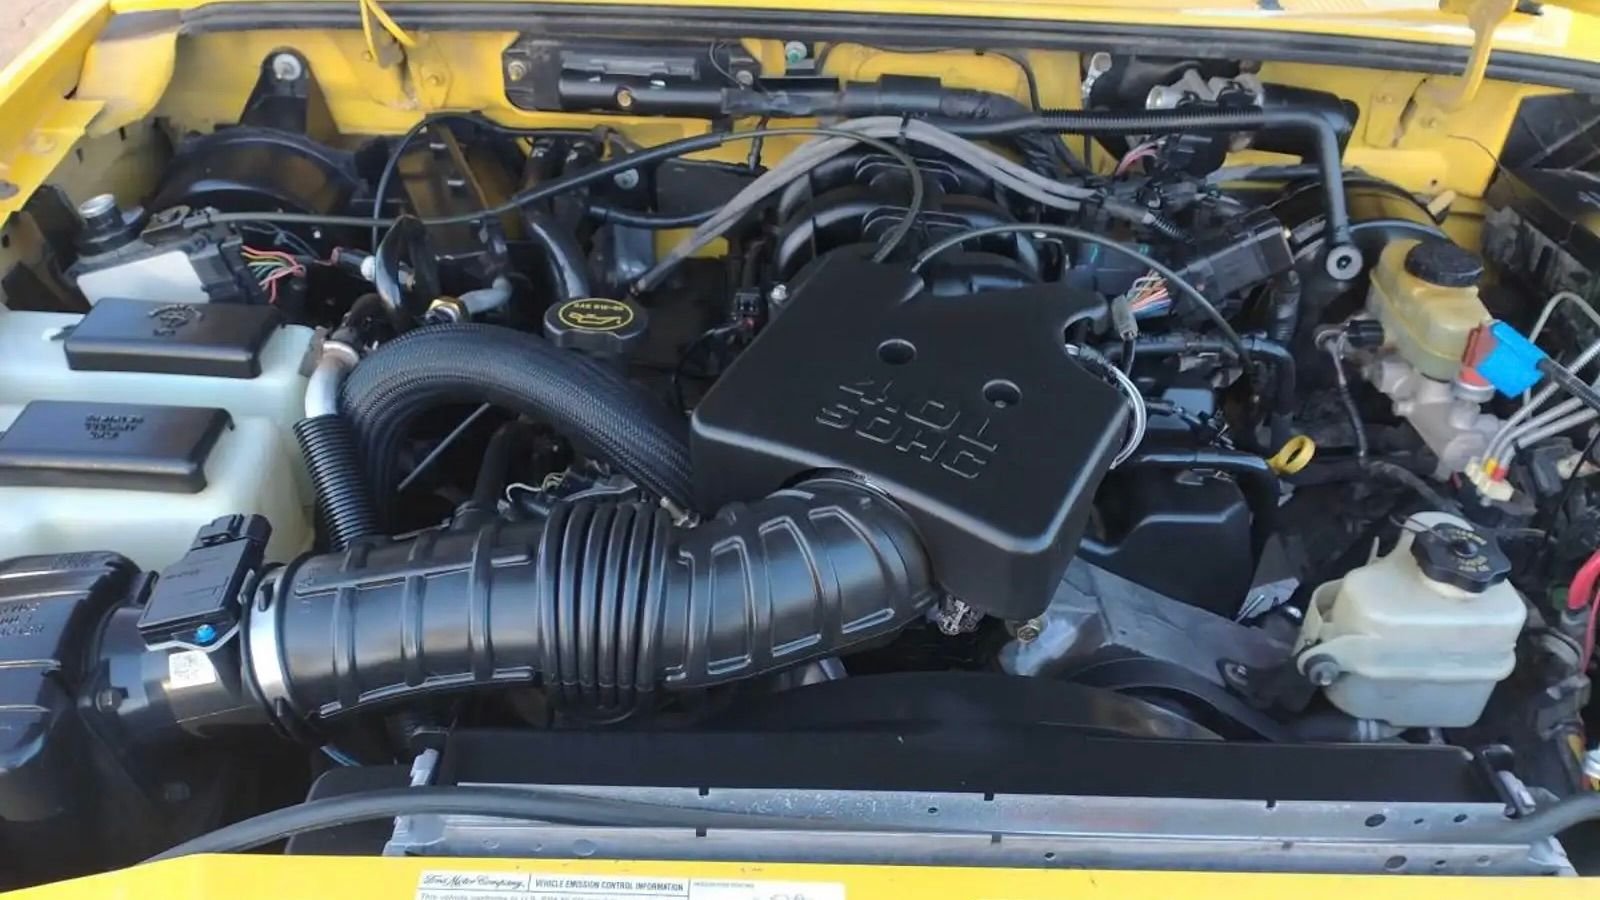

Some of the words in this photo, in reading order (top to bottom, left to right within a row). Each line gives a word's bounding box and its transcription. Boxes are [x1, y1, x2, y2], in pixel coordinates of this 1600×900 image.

[815, 404, 987, 478] SOHC
[535, 878, 564, 888] VEHICLE
[564, 879, 600, 889] EMISSION
[601, 881, 633, 891] CONTROL
[635, 882, 684, 892] INFORMATION
